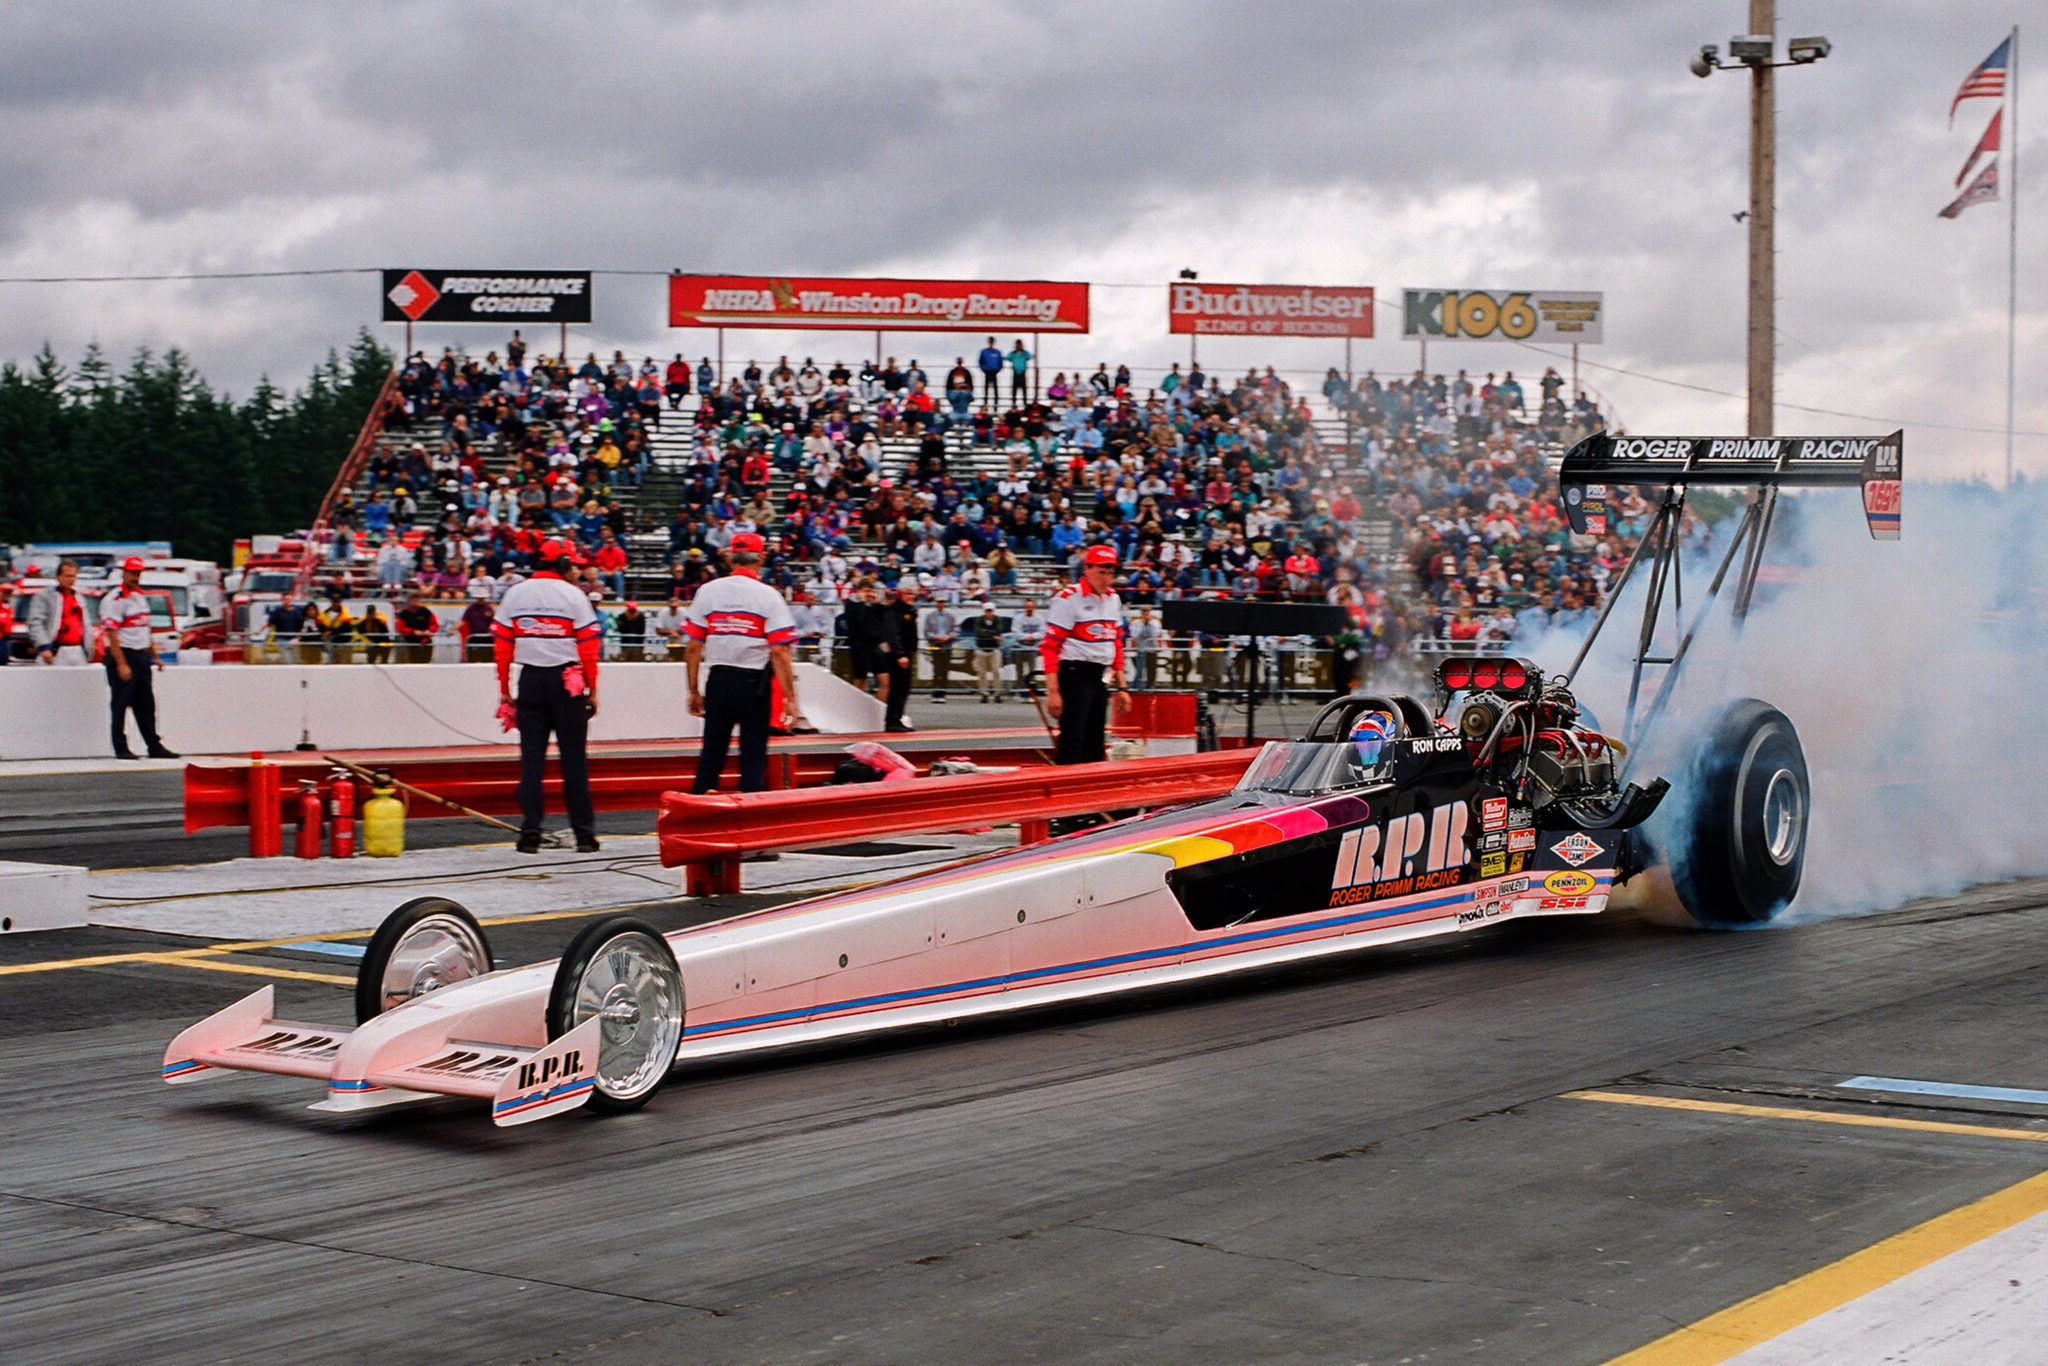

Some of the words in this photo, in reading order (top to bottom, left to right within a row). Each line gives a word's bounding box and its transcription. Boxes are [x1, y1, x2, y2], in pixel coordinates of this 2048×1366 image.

[440, 277, 586, 295] PERFORMANCE
[470, 296, 555, 313] CORNER
[702, 289, 776, 311] NHRA
[799, 291, 900, 313] Winston
[902, 293, 966, 320] Drag
[967, 294, 1061, 322] Racing
[1172, 286, 1370, 319] Budweiser
[1404, 291, 1537, 339] K106
[1251, 320, 1279, 333] OF
[1612, 440, 1692, 458] ROGER
[1708, 440, 1781, 458] PRIMM
[1412, 740, 1434, 754] RON
[1435, 738, 1462, 752] CAPPS
[1329, 885, 1371, 907] ROGER
[1374, 876, 1414, 899] PRIMM
[1415, 868, 1461, 890] RACING
[1551, 877, 1588, 888] PENNZOIL
